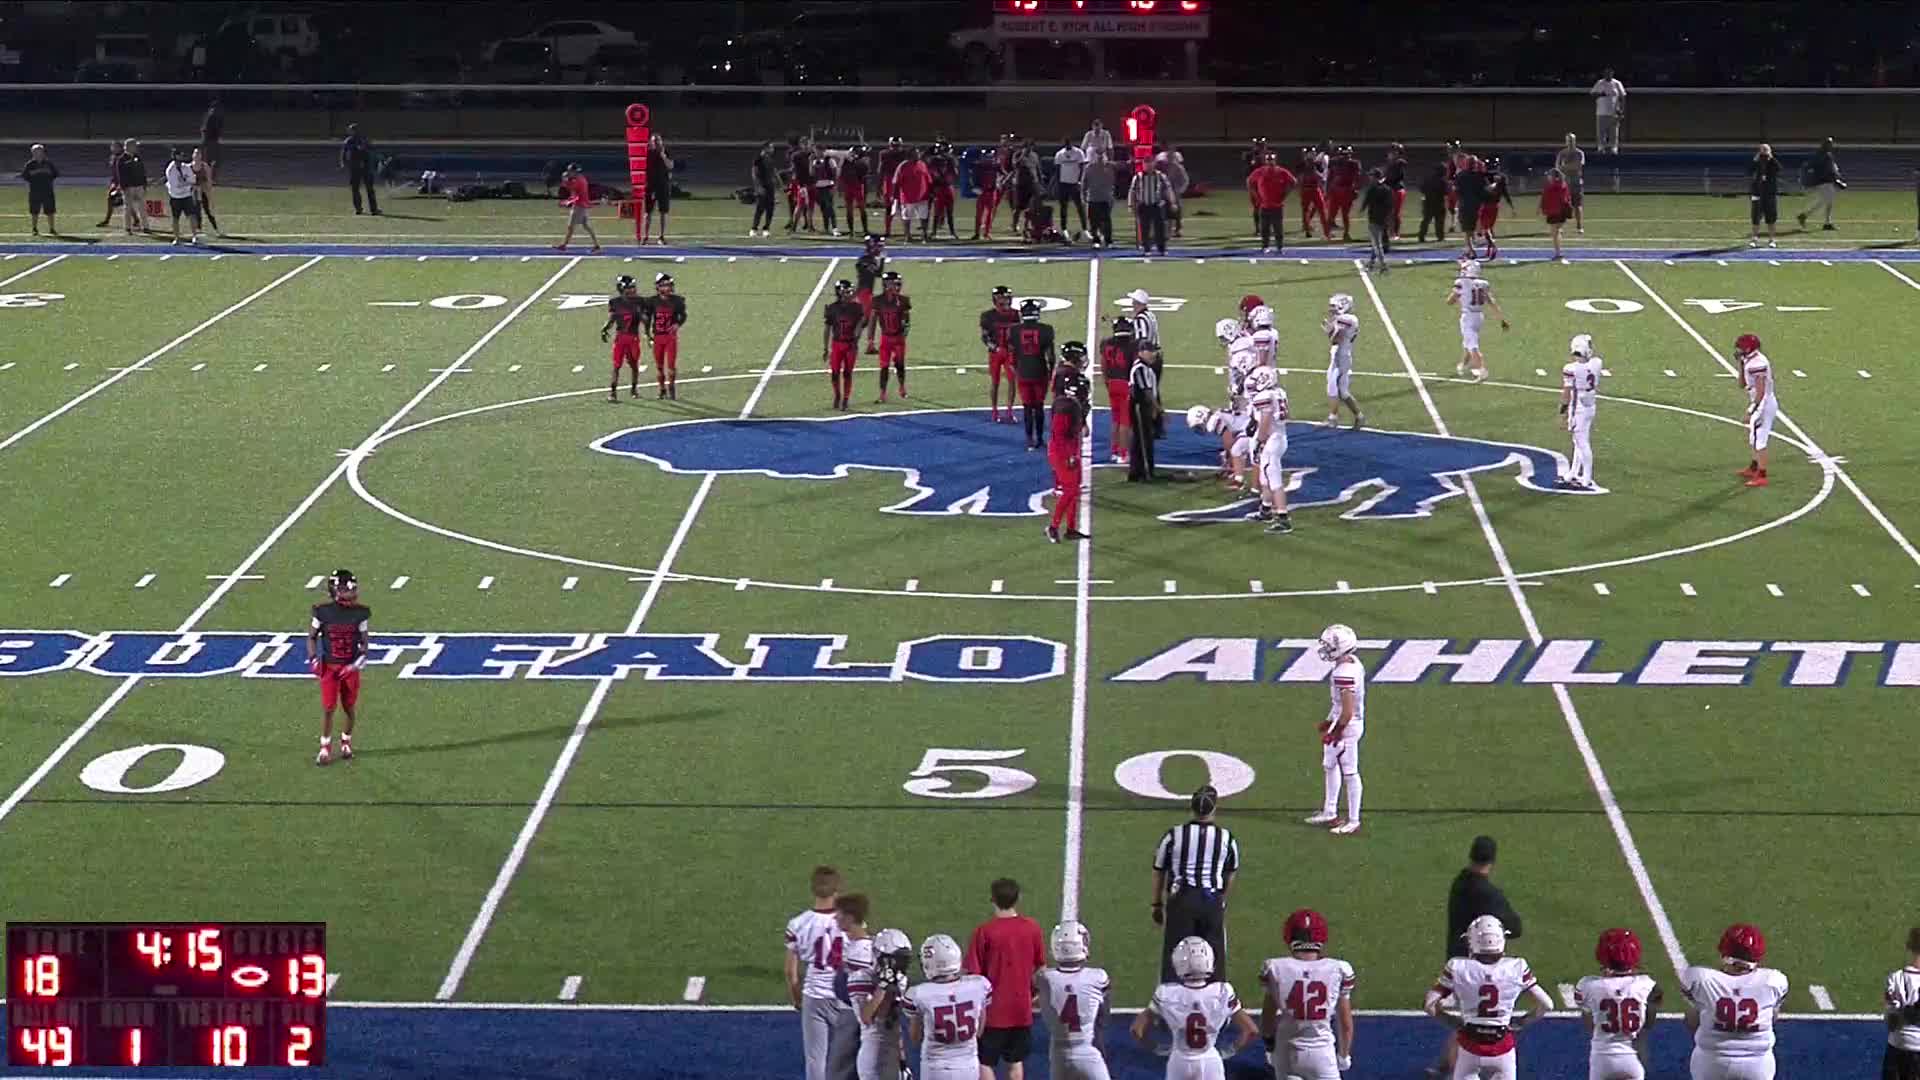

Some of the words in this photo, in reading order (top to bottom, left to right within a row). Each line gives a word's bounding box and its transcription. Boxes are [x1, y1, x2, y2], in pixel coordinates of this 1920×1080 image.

[1126, 118, 1137, 141] 1
[1058, 994, 1082, 1032] 4
[1286, 980, 1327, 1021] 42
[1478, 984, 1499, 1018] 2
[1600, 998, 1639, 1033] 36
[1714, 997, 1759, 1032] 92
[934, 1001, 976, 1044] 55
[1186, 1012, 1207, 1049] 6
